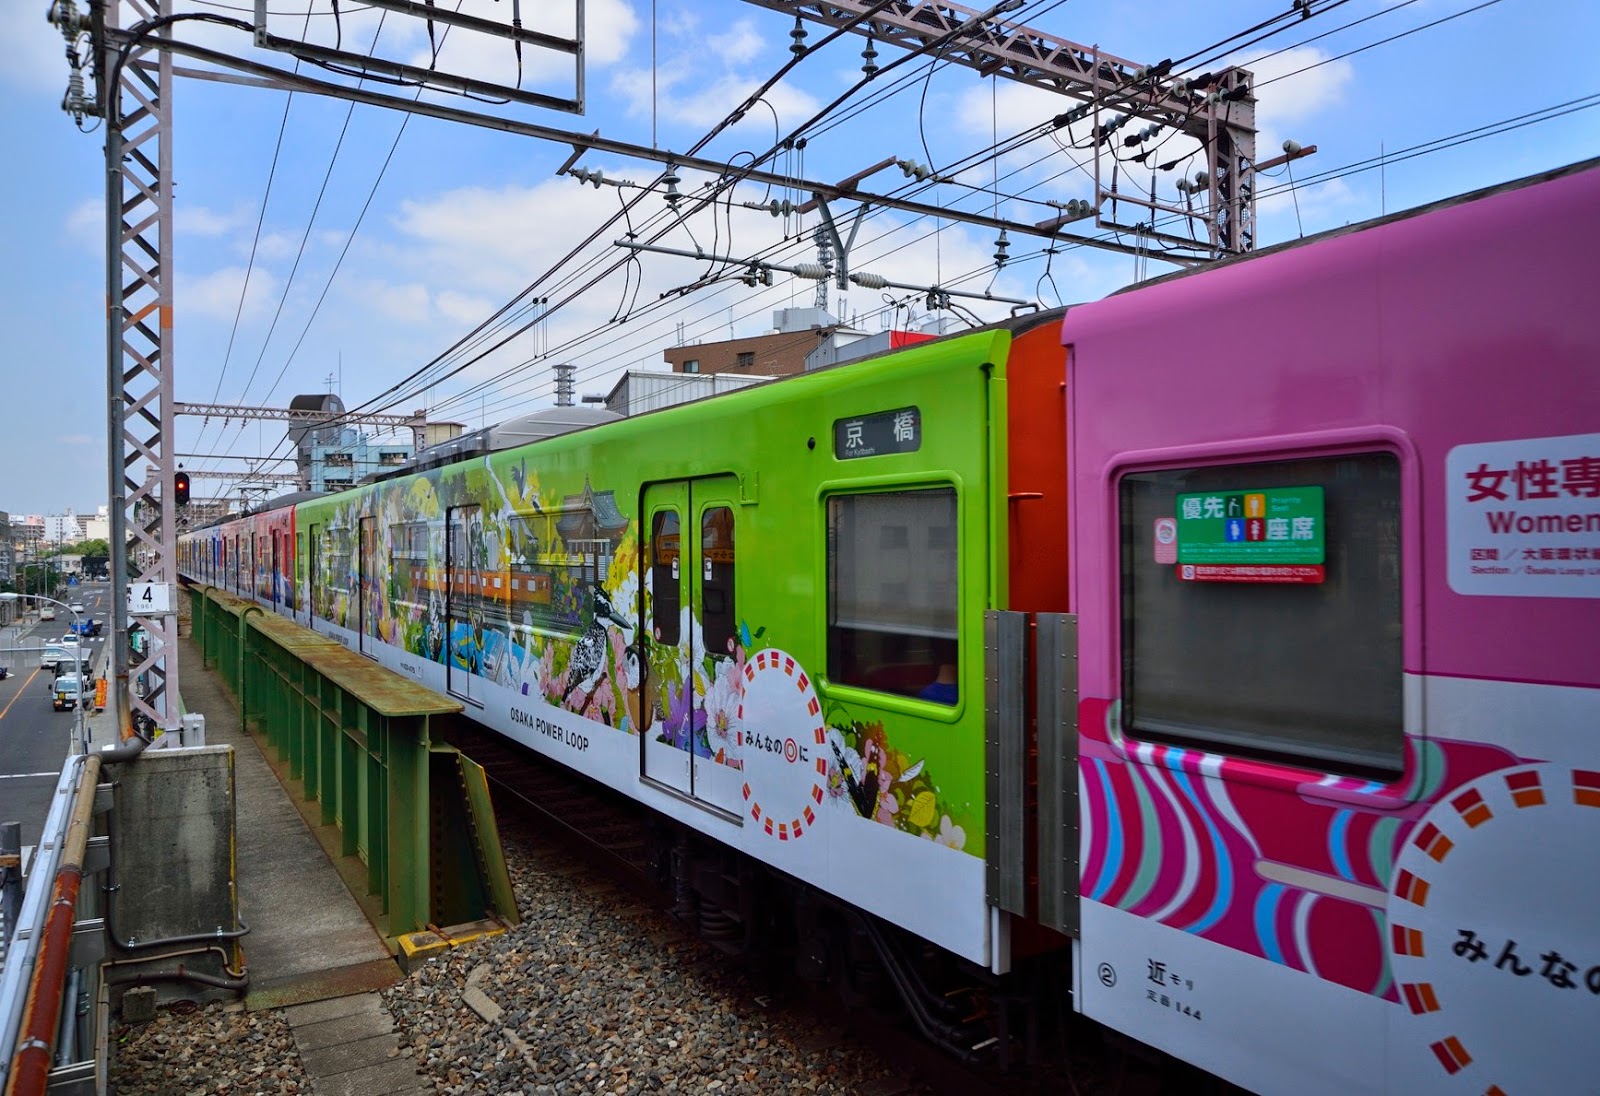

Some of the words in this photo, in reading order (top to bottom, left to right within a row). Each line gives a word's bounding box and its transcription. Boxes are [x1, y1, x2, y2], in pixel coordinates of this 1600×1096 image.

[1182, 497, 1225, 519] 優先
[1266, 517, 1315, 540] 座席
[142, 586, 152, 603] 4
[510, 707, 534, 729] OSAKA
[536, 718, 563, 742] POWER
[565, 730, 589, 752] LOOP
